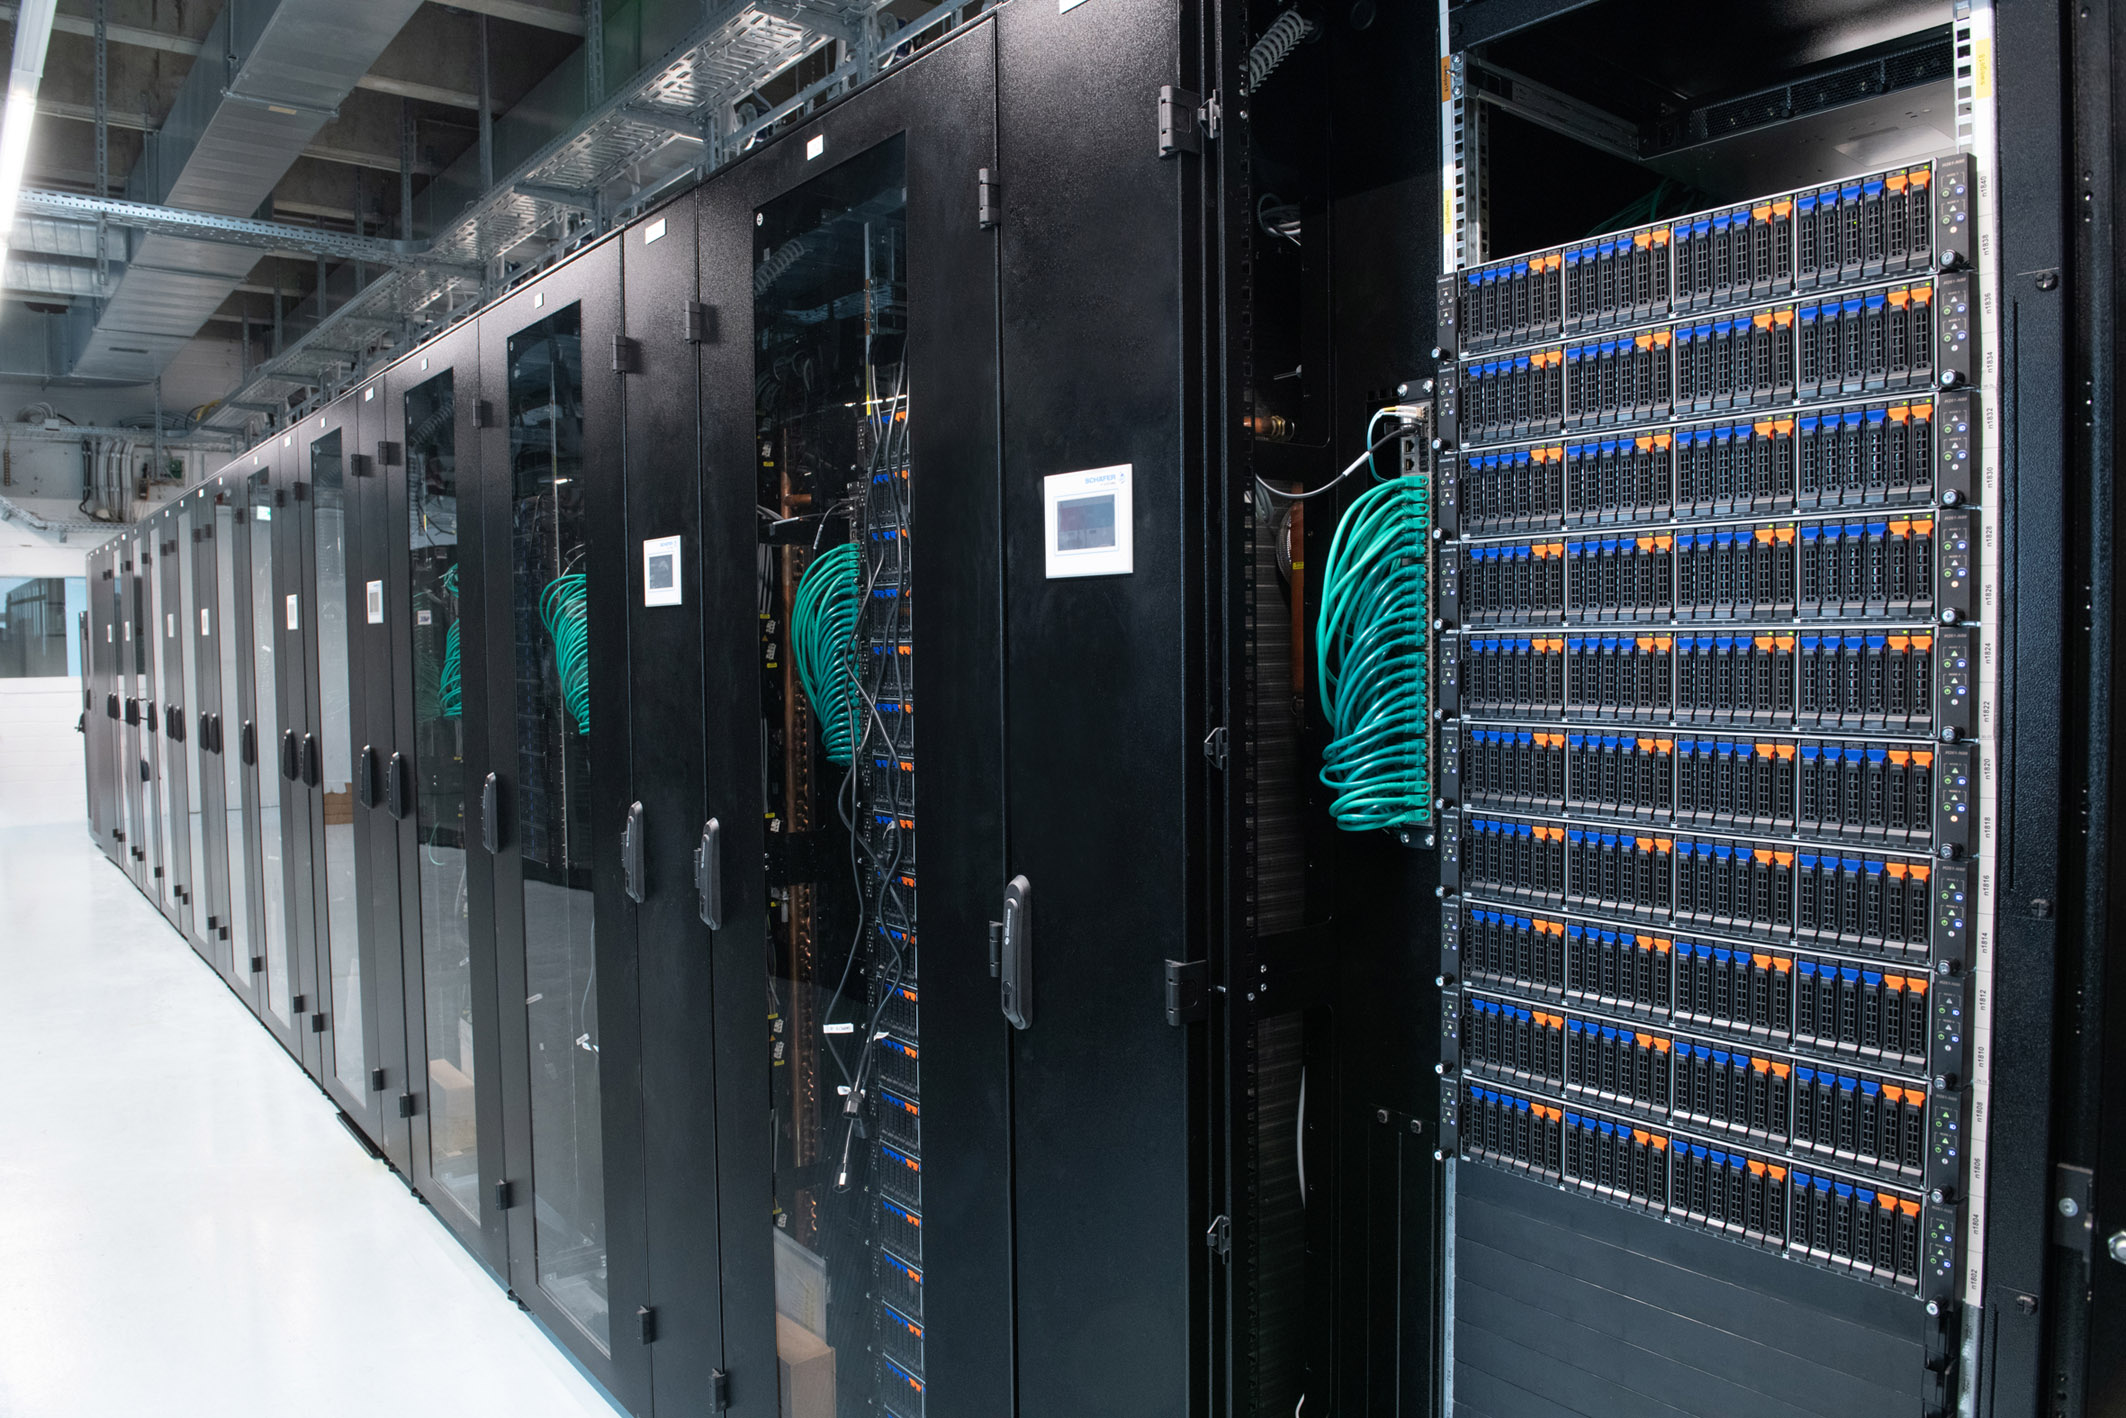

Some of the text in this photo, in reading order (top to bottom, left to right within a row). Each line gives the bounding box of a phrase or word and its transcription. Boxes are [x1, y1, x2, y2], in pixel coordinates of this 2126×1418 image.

[1984, 292, 1992, 314] n1836
[1979, 989, 1987, 1010] n1812
[1970, 1269, 1978, 1289] n1802
